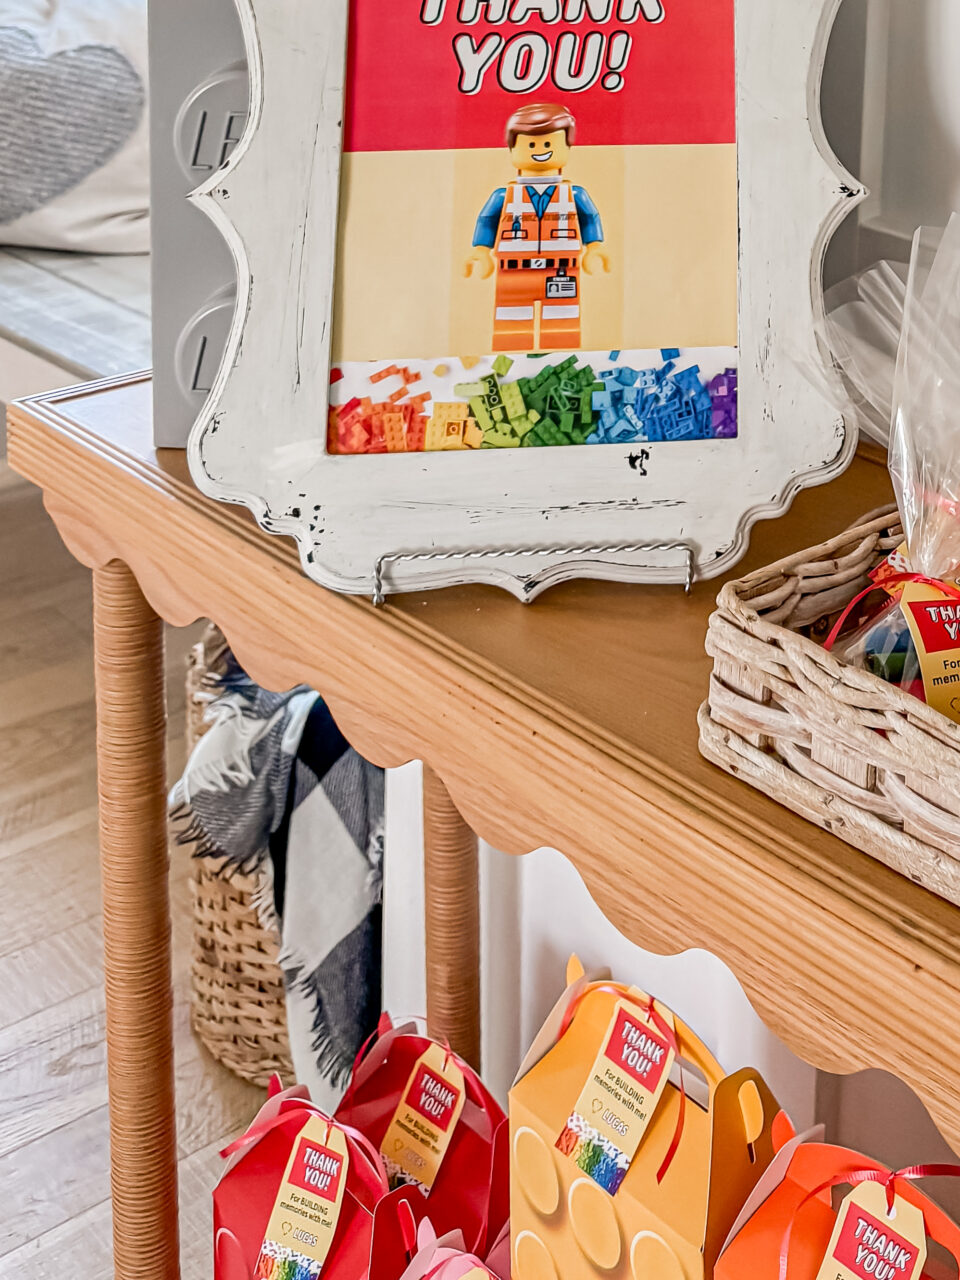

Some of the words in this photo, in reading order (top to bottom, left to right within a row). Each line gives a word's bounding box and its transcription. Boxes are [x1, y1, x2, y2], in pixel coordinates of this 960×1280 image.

[452, 30, 633, 95] YOU!
[943, 659, 960, 669] For
[622, 1021, 665, 1065] THANK
[621, 1043, 653, 1078] YOU!
[421, 1073, 455, 1108] THANK
[605, 1068, 616, 1081] For
[615, 1077, 644, 1105] BUILDING
[419, 1092, 445, 1119] YOU!
[602, 1108, 629, 1136] LUCAS
[303, 1147, 340, 1178] THANK
[304, 1166, 332, 1191] YOU!
[290, 1193, 301, 1203] For
[301, 1197, 328, 1216] BUILDING
[293, 1226, 318, 1247] LUCAS
[854, 1217, 911, 1272] THANK
